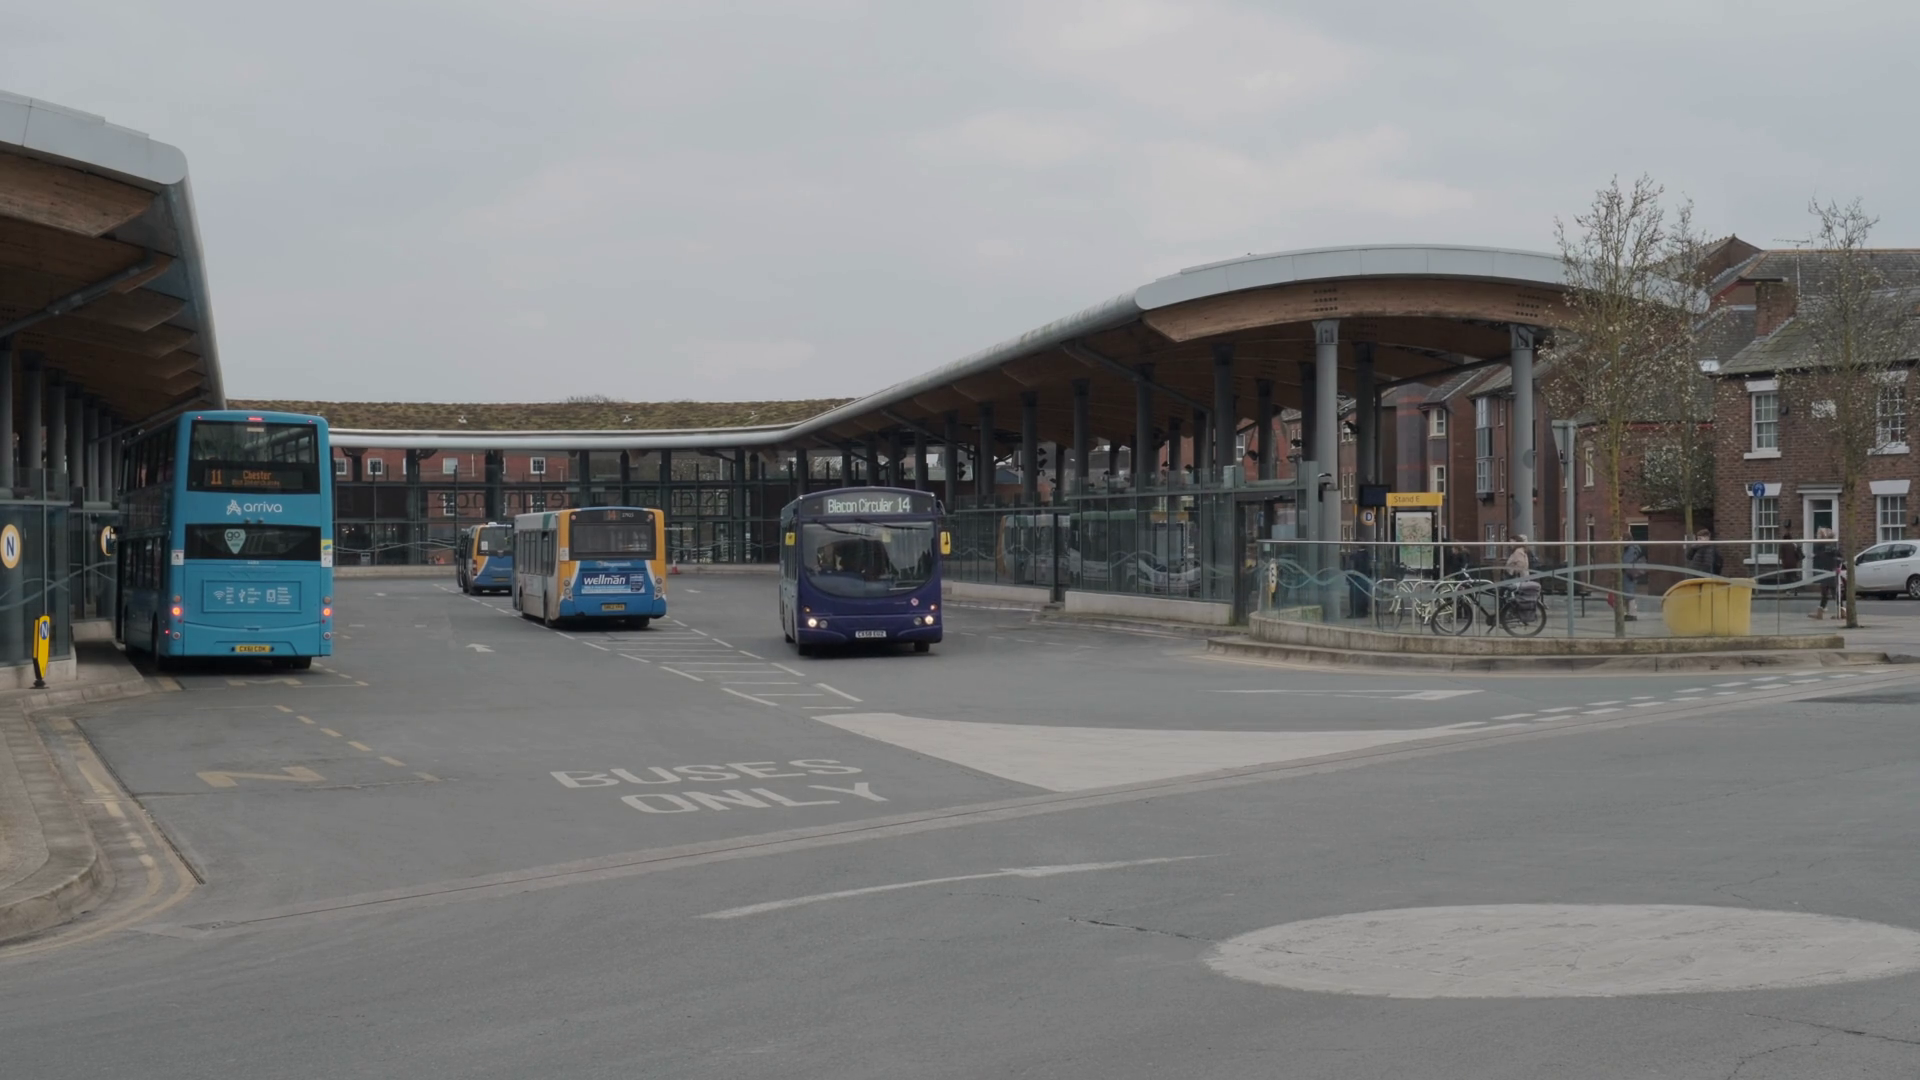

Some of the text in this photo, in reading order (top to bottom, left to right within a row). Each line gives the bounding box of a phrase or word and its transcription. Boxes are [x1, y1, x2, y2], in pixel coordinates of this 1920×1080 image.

[211, 469, 222, 485] 11
[827, 496, 910, 514] Blacon Circular 14
[1394, 495, 1421, 503] Stand E
[243, 502, 282, 513] arriva
[226, 531, 241, 542] go
[6, 535, 15, 557] N
[583, 574, 626, 585] wellman
[550, 758, 862, 788] BUSES
[621, 781, 890, 814] ONLY
